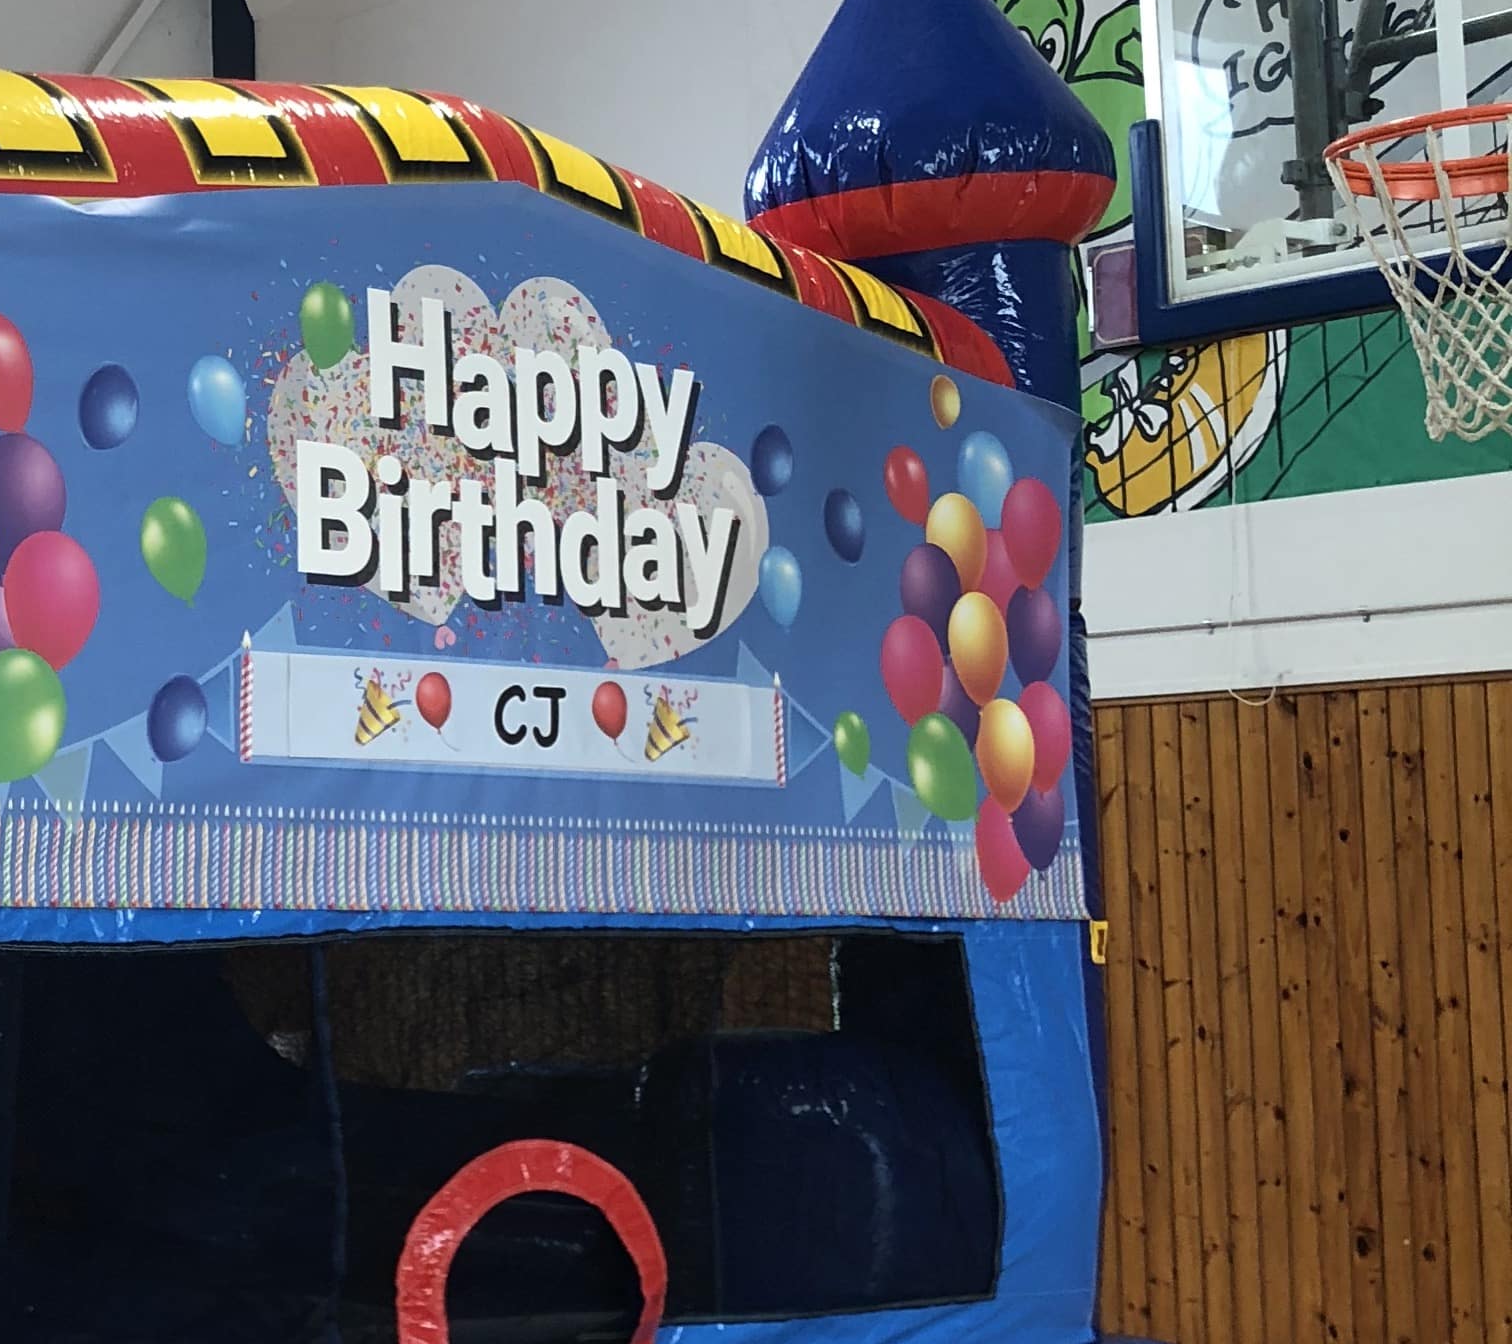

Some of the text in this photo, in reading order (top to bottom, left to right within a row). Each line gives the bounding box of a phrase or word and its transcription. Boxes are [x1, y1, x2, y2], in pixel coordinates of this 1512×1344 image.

[367, 288, 697, 496] Happy
[297, 439, 737, 633] Birthday
[494, 684, 567, 748] CJ
